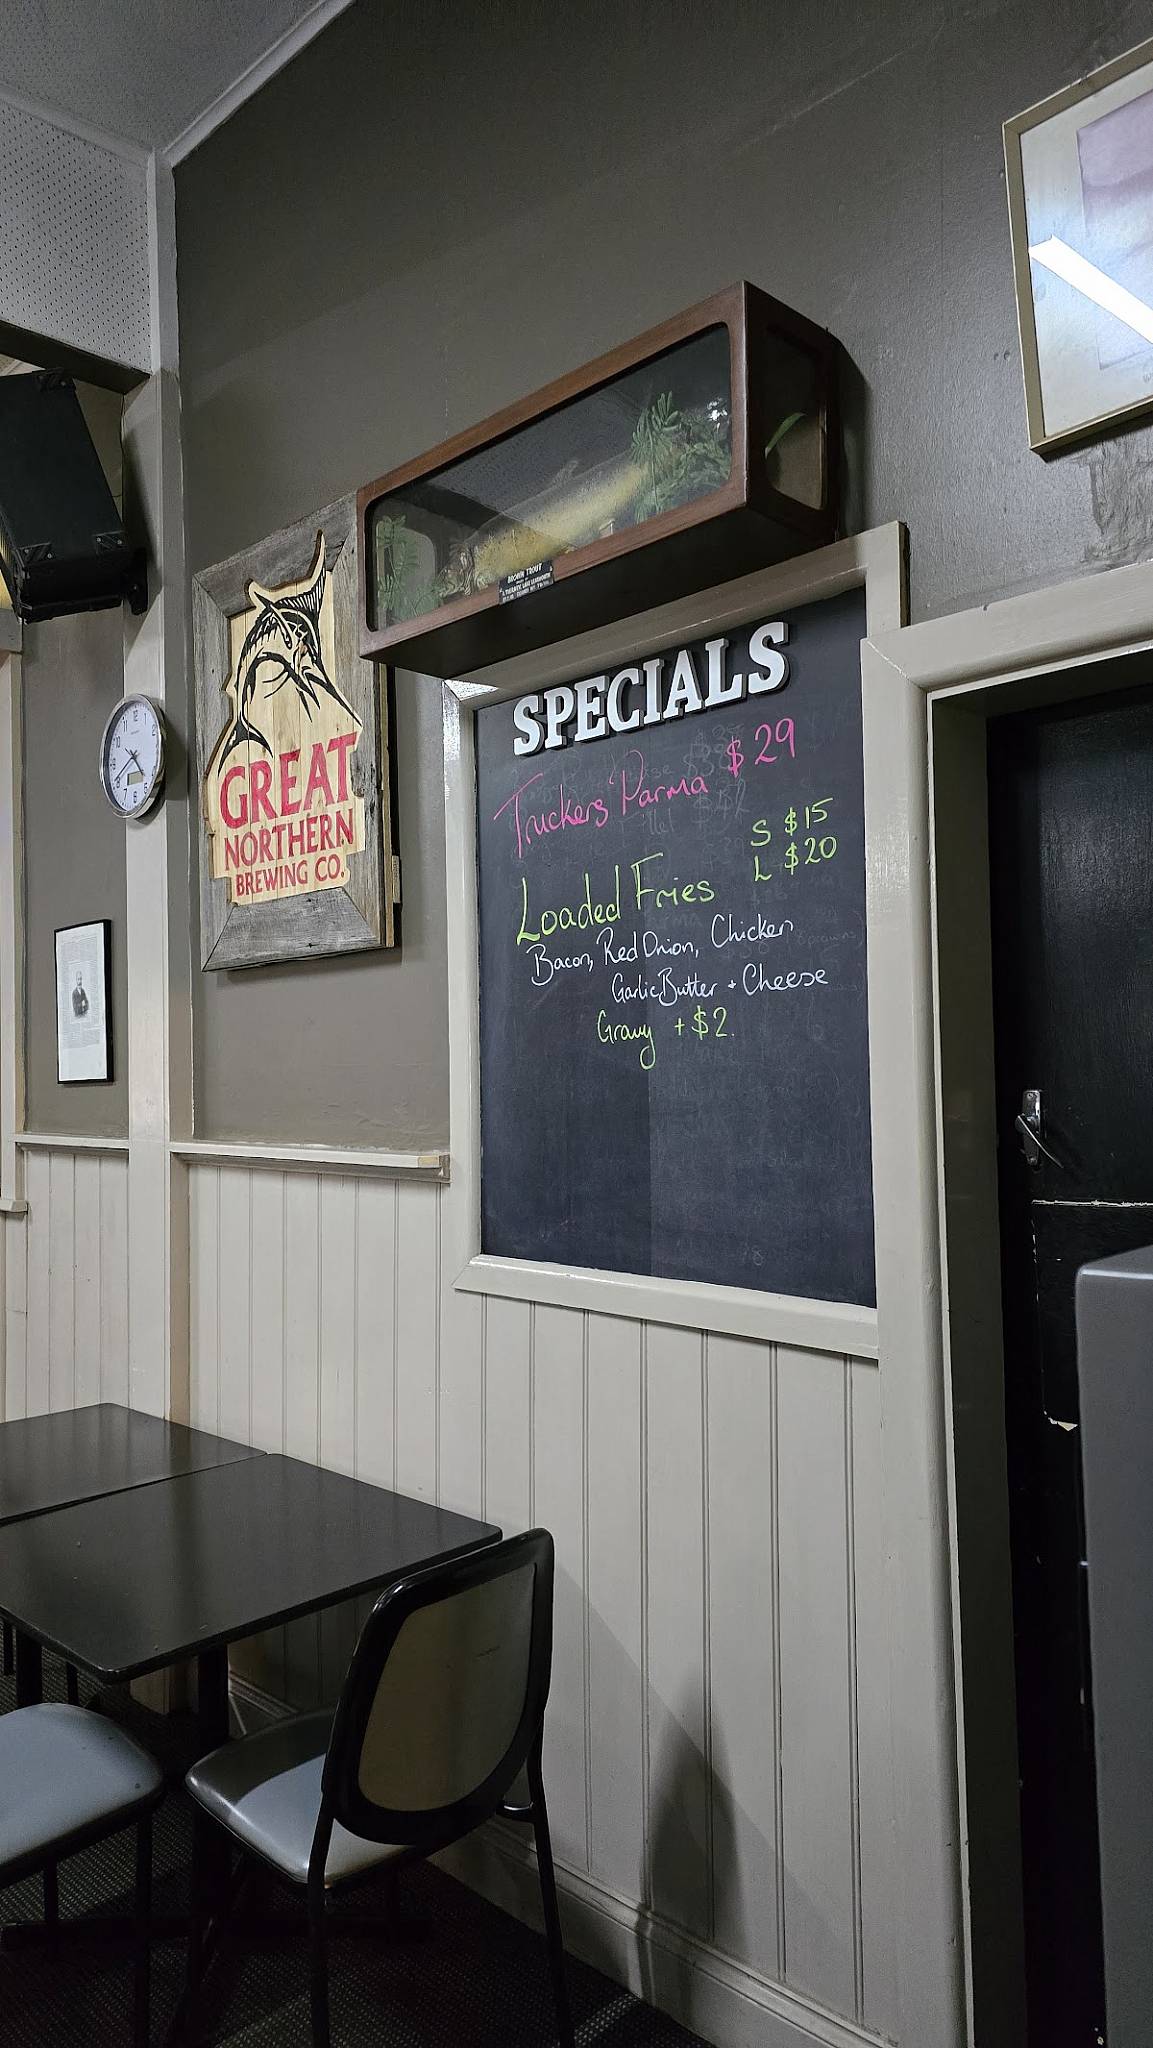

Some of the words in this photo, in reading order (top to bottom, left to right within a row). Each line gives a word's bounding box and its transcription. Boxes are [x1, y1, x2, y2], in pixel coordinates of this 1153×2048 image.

[513, 621, 789, 757] SPECIALS
[220, 731, 358, 829] GREAT
[609, 748, 709, 817] Parma
[224, 808, 354, 871] NORTHERN
[750, 819, 772, 847] S
[784, 797, 834, 837] $15
[236, 859, 308, 897] BREWING
[754, 855, 773, 882] L
[784, 836, 838, 876] $20
[516, 864, 622, 946] Loaded
[630, 851, 716, 911] Fries
[526, 942, 594, 987] Bacon,
[711, 912, 794, 949] Chicken
[742, 962, 829, 996] Cheese
[597, 1009, 656, 1071] Gravy
